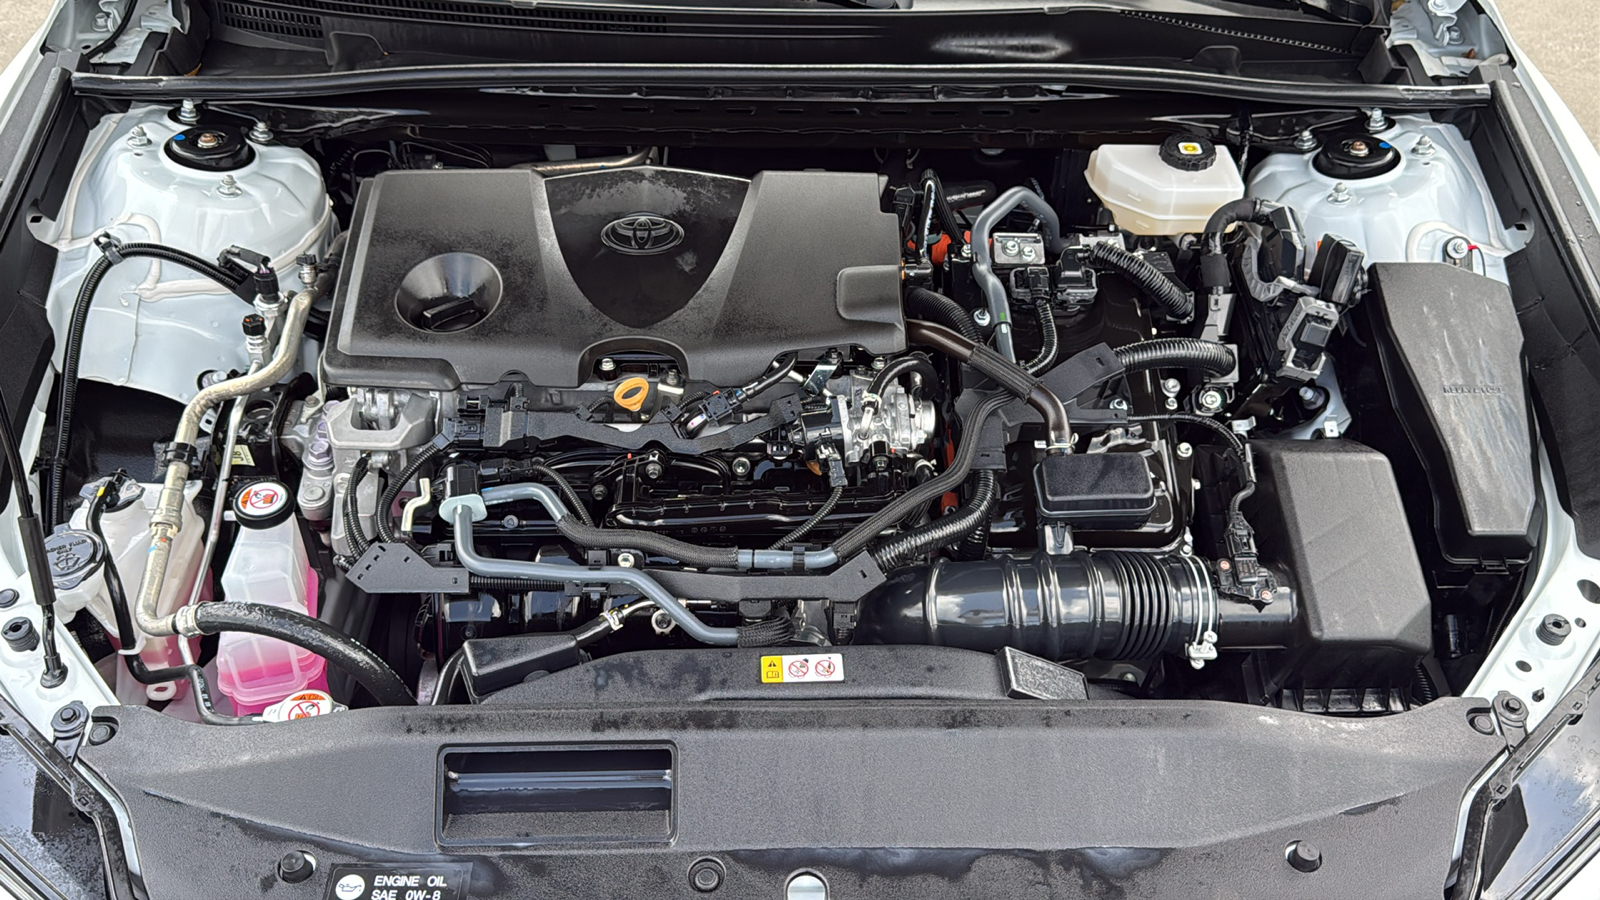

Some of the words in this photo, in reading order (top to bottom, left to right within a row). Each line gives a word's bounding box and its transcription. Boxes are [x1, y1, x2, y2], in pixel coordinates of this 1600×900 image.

[46, 545, 66, 553] ASHER
[374, 875, 420, 887] ENGINE
[427, 875, 447, 887] OIL
[371, 889, 398, 900] SAE
